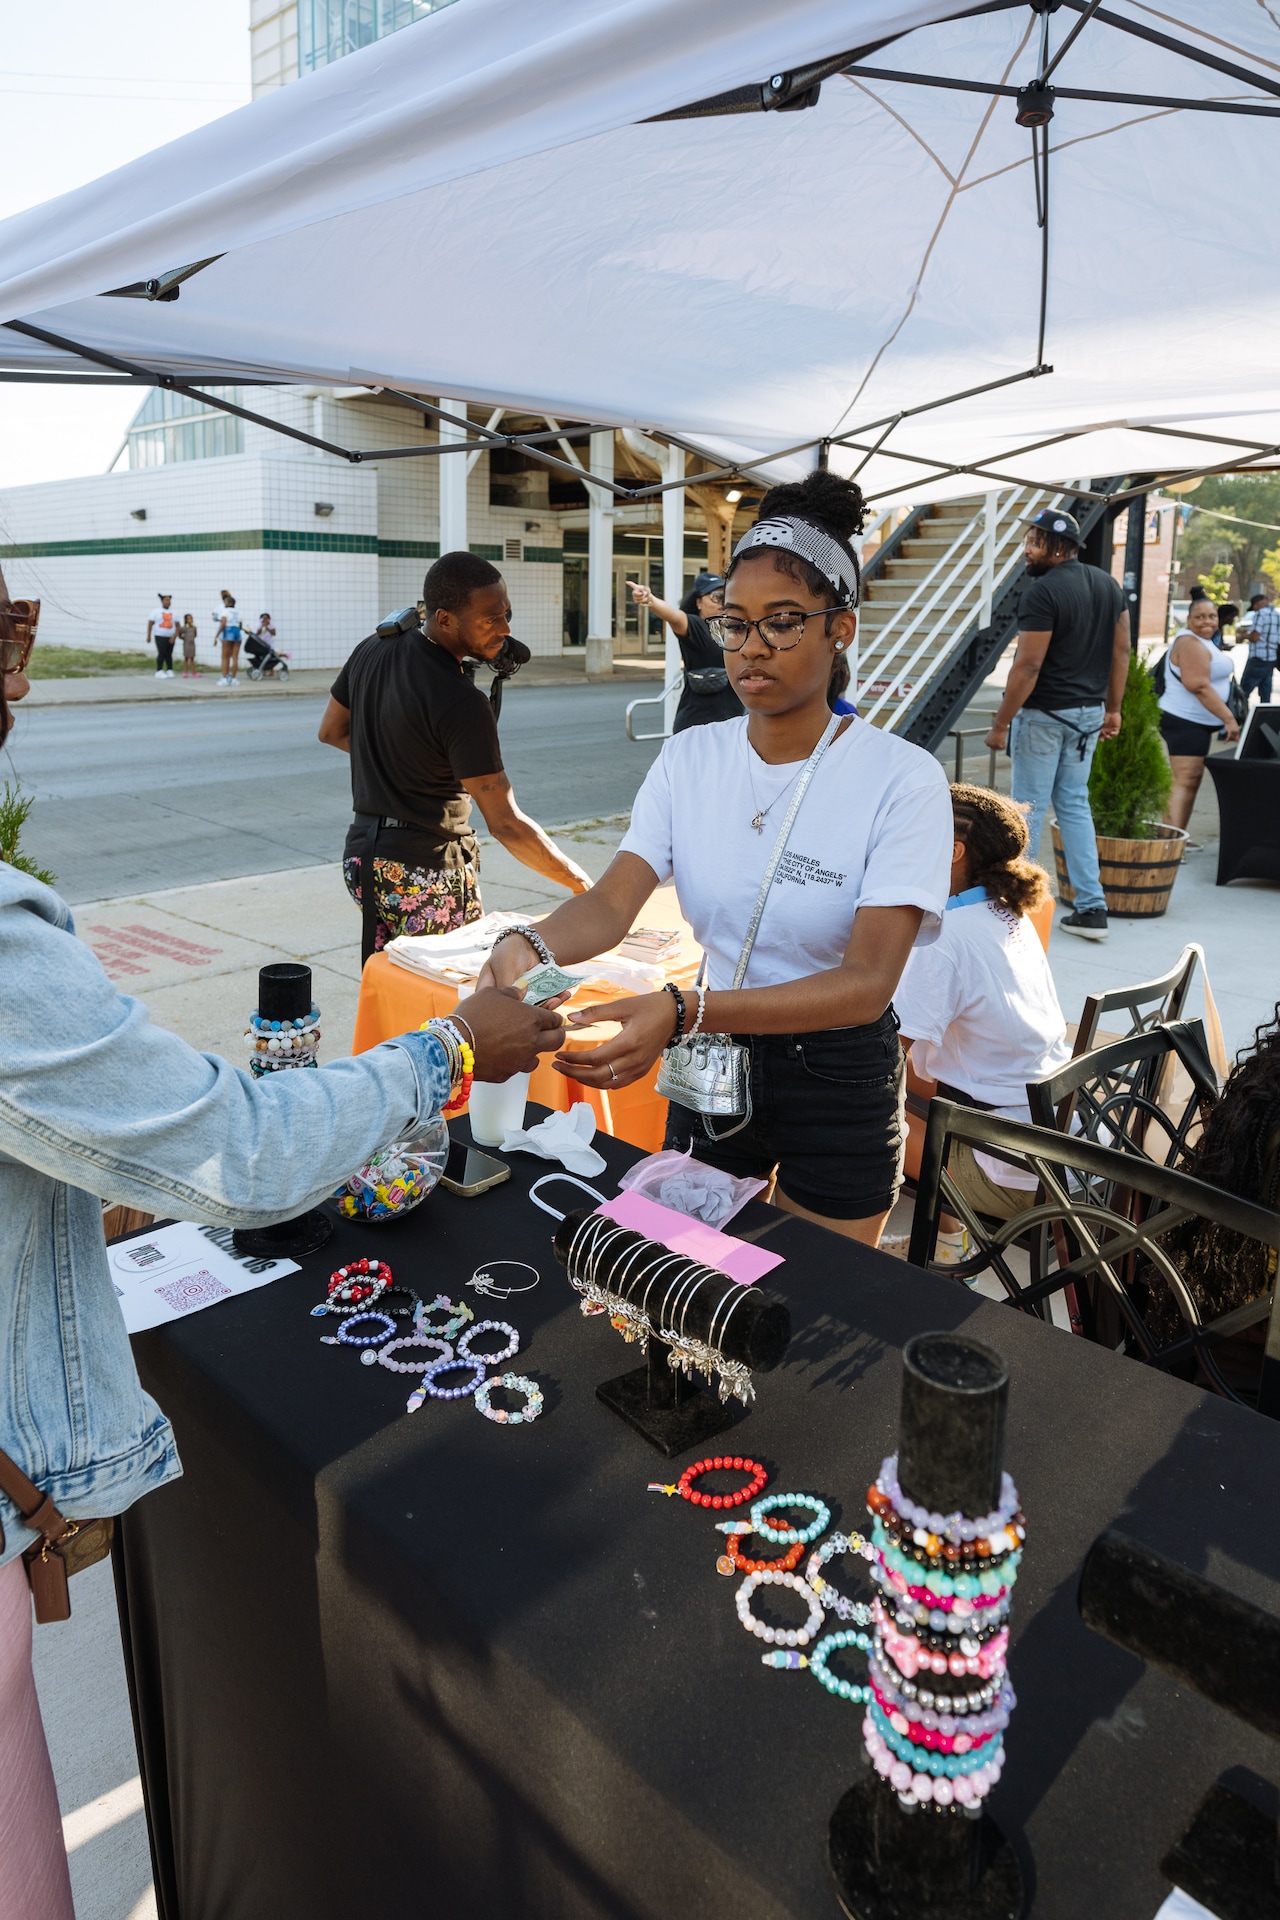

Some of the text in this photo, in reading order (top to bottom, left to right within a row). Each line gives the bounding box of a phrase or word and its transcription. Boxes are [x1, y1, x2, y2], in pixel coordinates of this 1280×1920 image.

[783, 850, 821, 867] LOS ANGELES
[792, 861, 804, 870] CITY
[776, 870, 806, 886] CALIFORNIA
[242, 1258, 277, 1274] US
